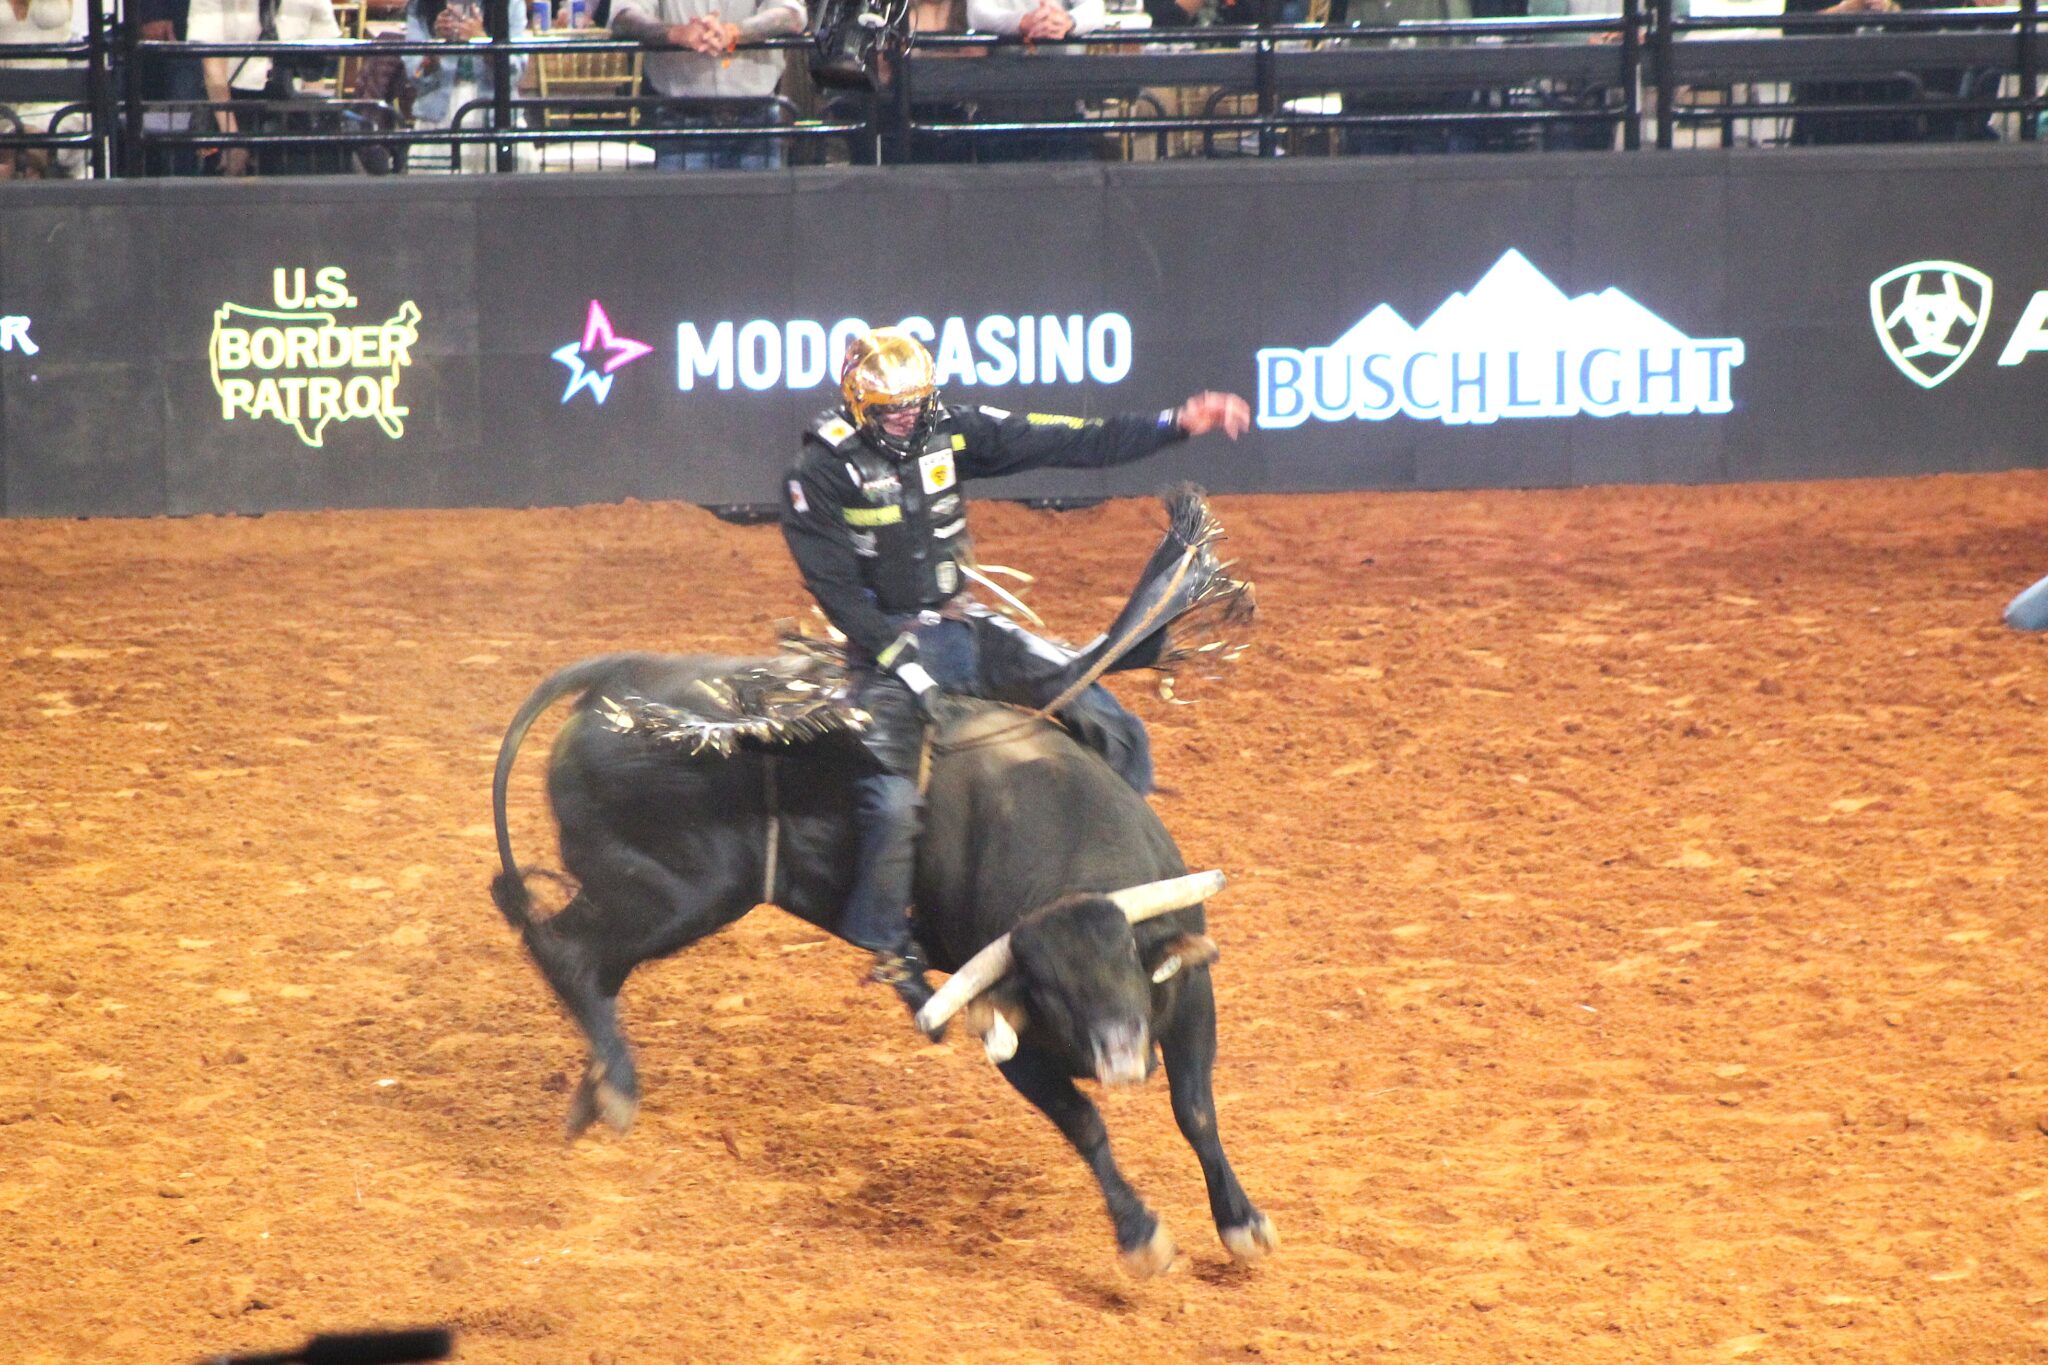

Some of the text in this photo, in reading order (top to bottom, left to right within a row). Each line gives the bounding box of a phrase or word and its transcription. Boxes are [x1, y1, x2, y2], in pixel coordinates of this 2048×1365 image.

[273, 266, 358, 309] U.S.
[217, 325, 412, 369] BORDER
[222, 375, 410, 420] PATROL
